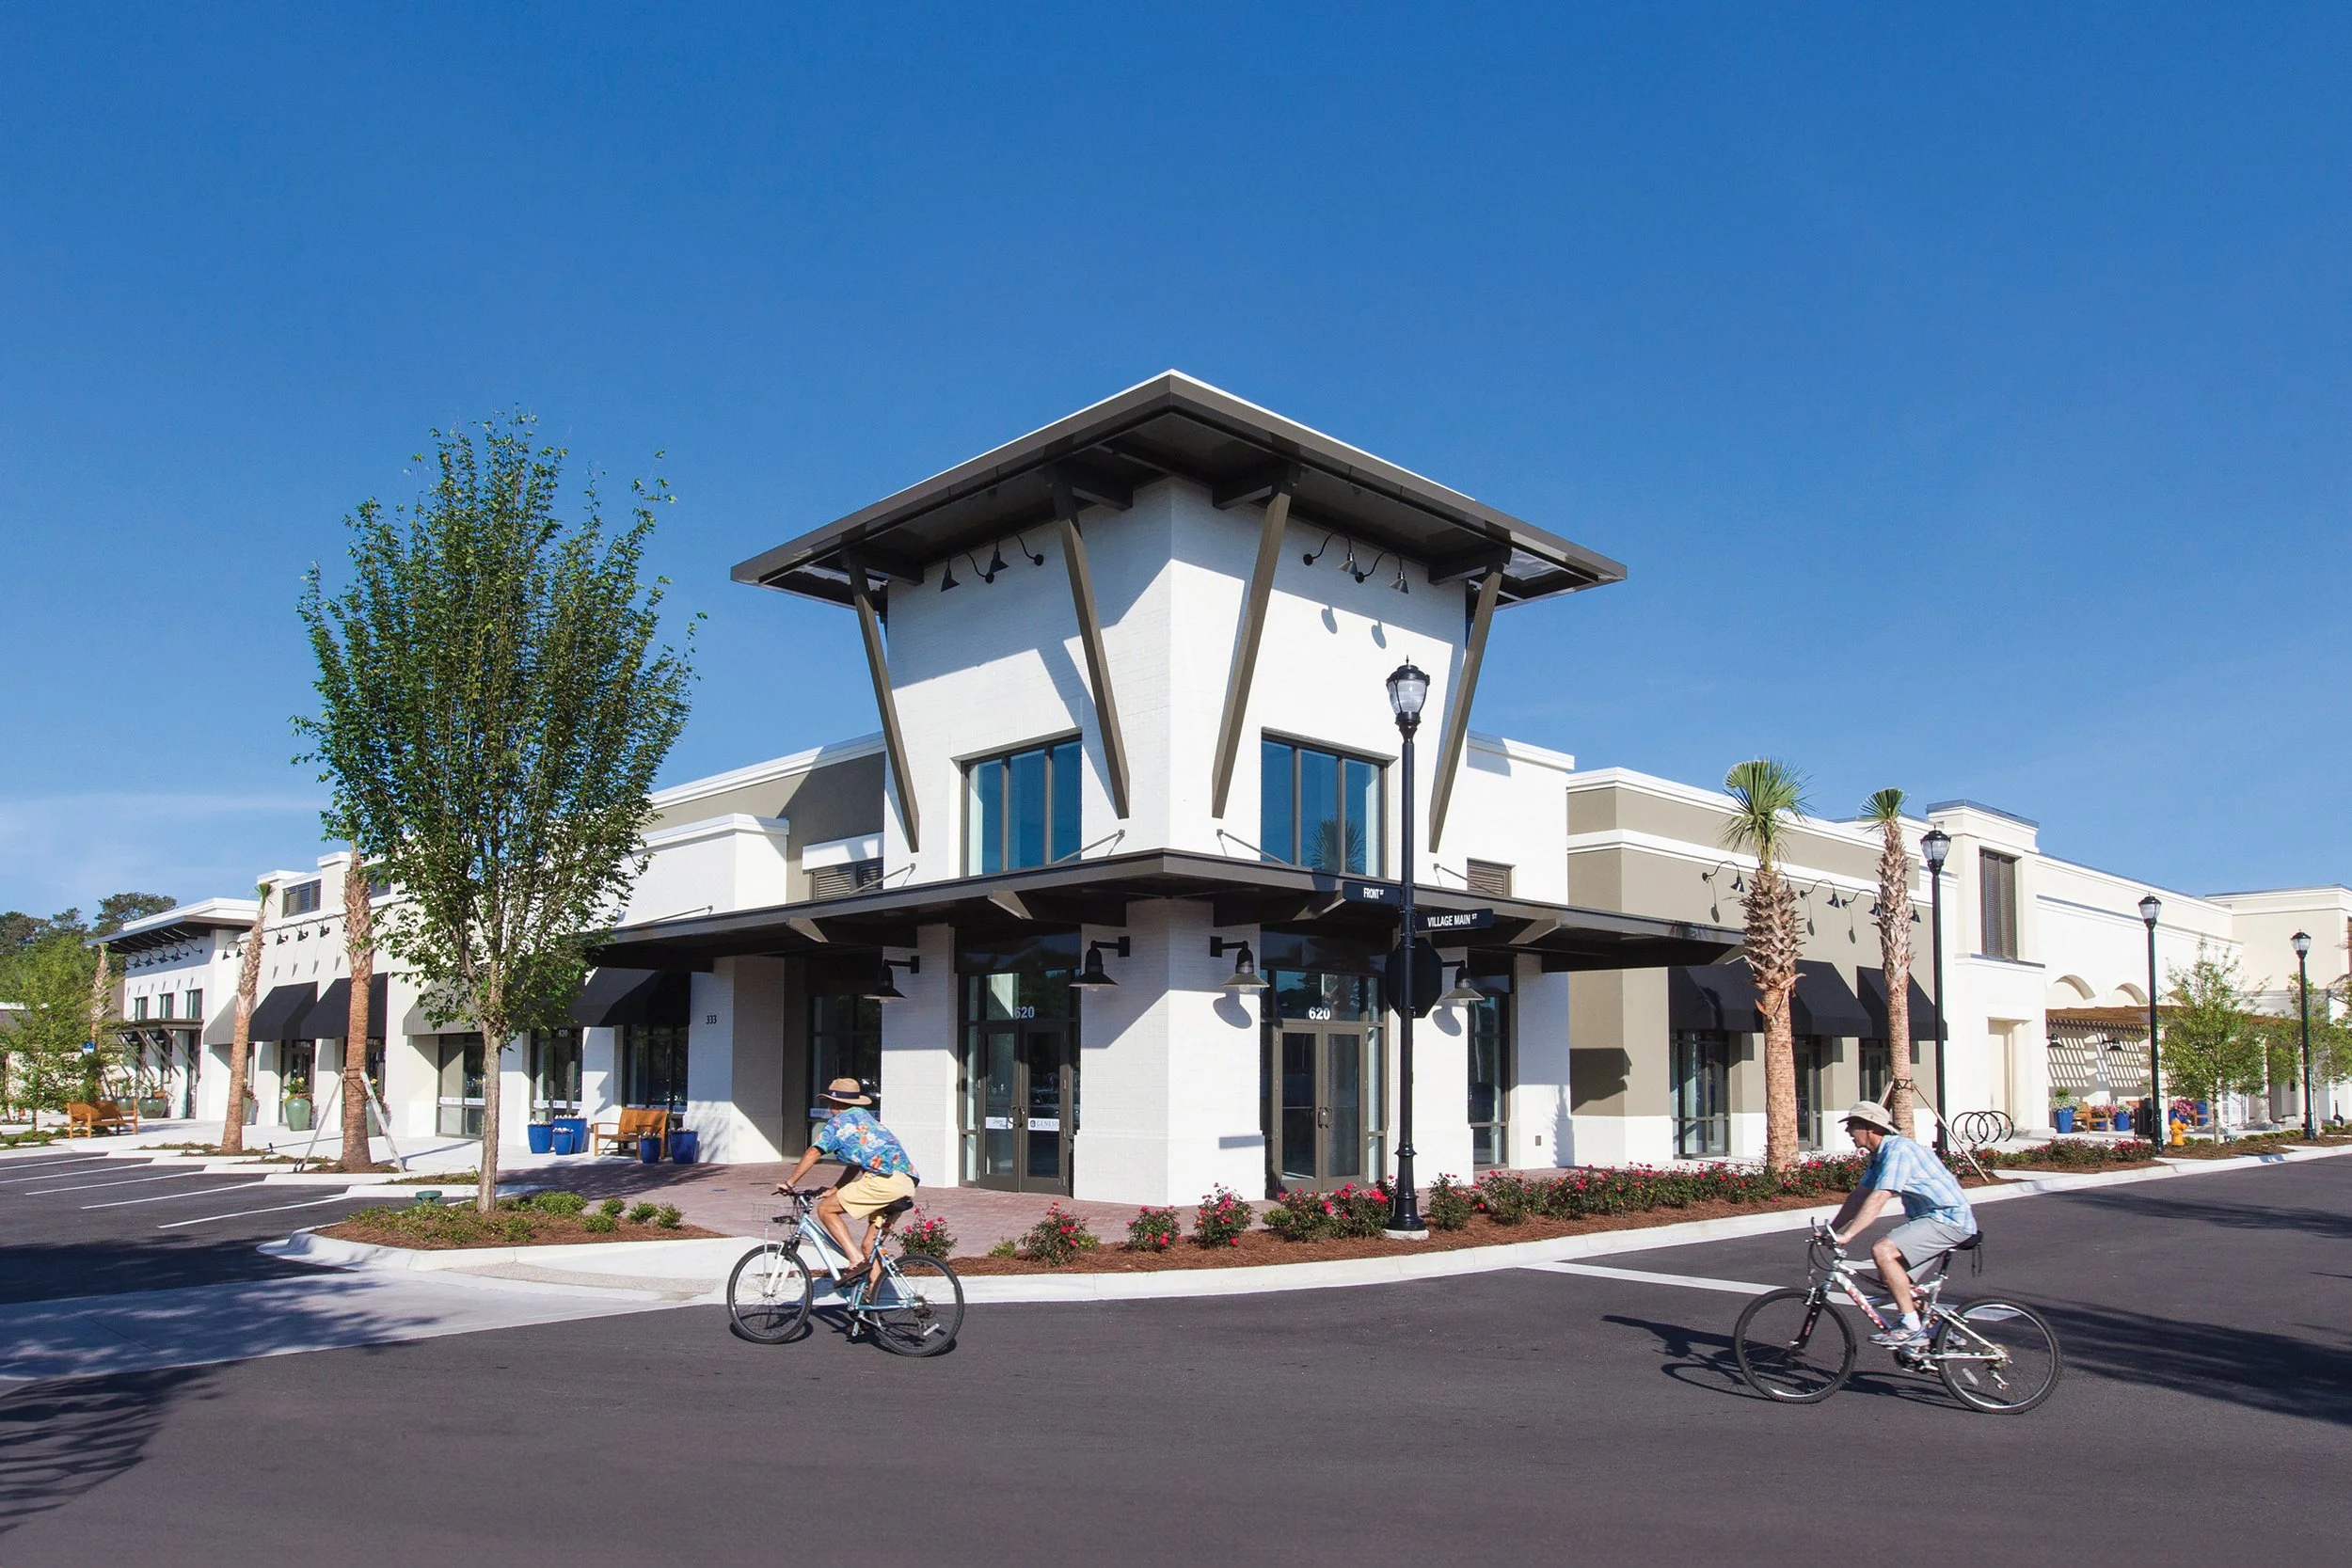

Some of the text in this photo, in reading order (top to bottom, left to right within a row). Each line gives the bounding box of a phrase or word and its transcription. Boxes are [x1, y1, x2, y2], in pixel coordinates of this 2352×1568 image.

[1363, 887, 1380, 899] FRONT
[1427, 915, 1454, 927] VILLAGE
[1454, 914, 1471, 926] MAIN
[706, 1015, 717, 1024] 333
[1014, 1006, 1035, 1020] 620
[1309, 1006, 1330, 1021] 620
